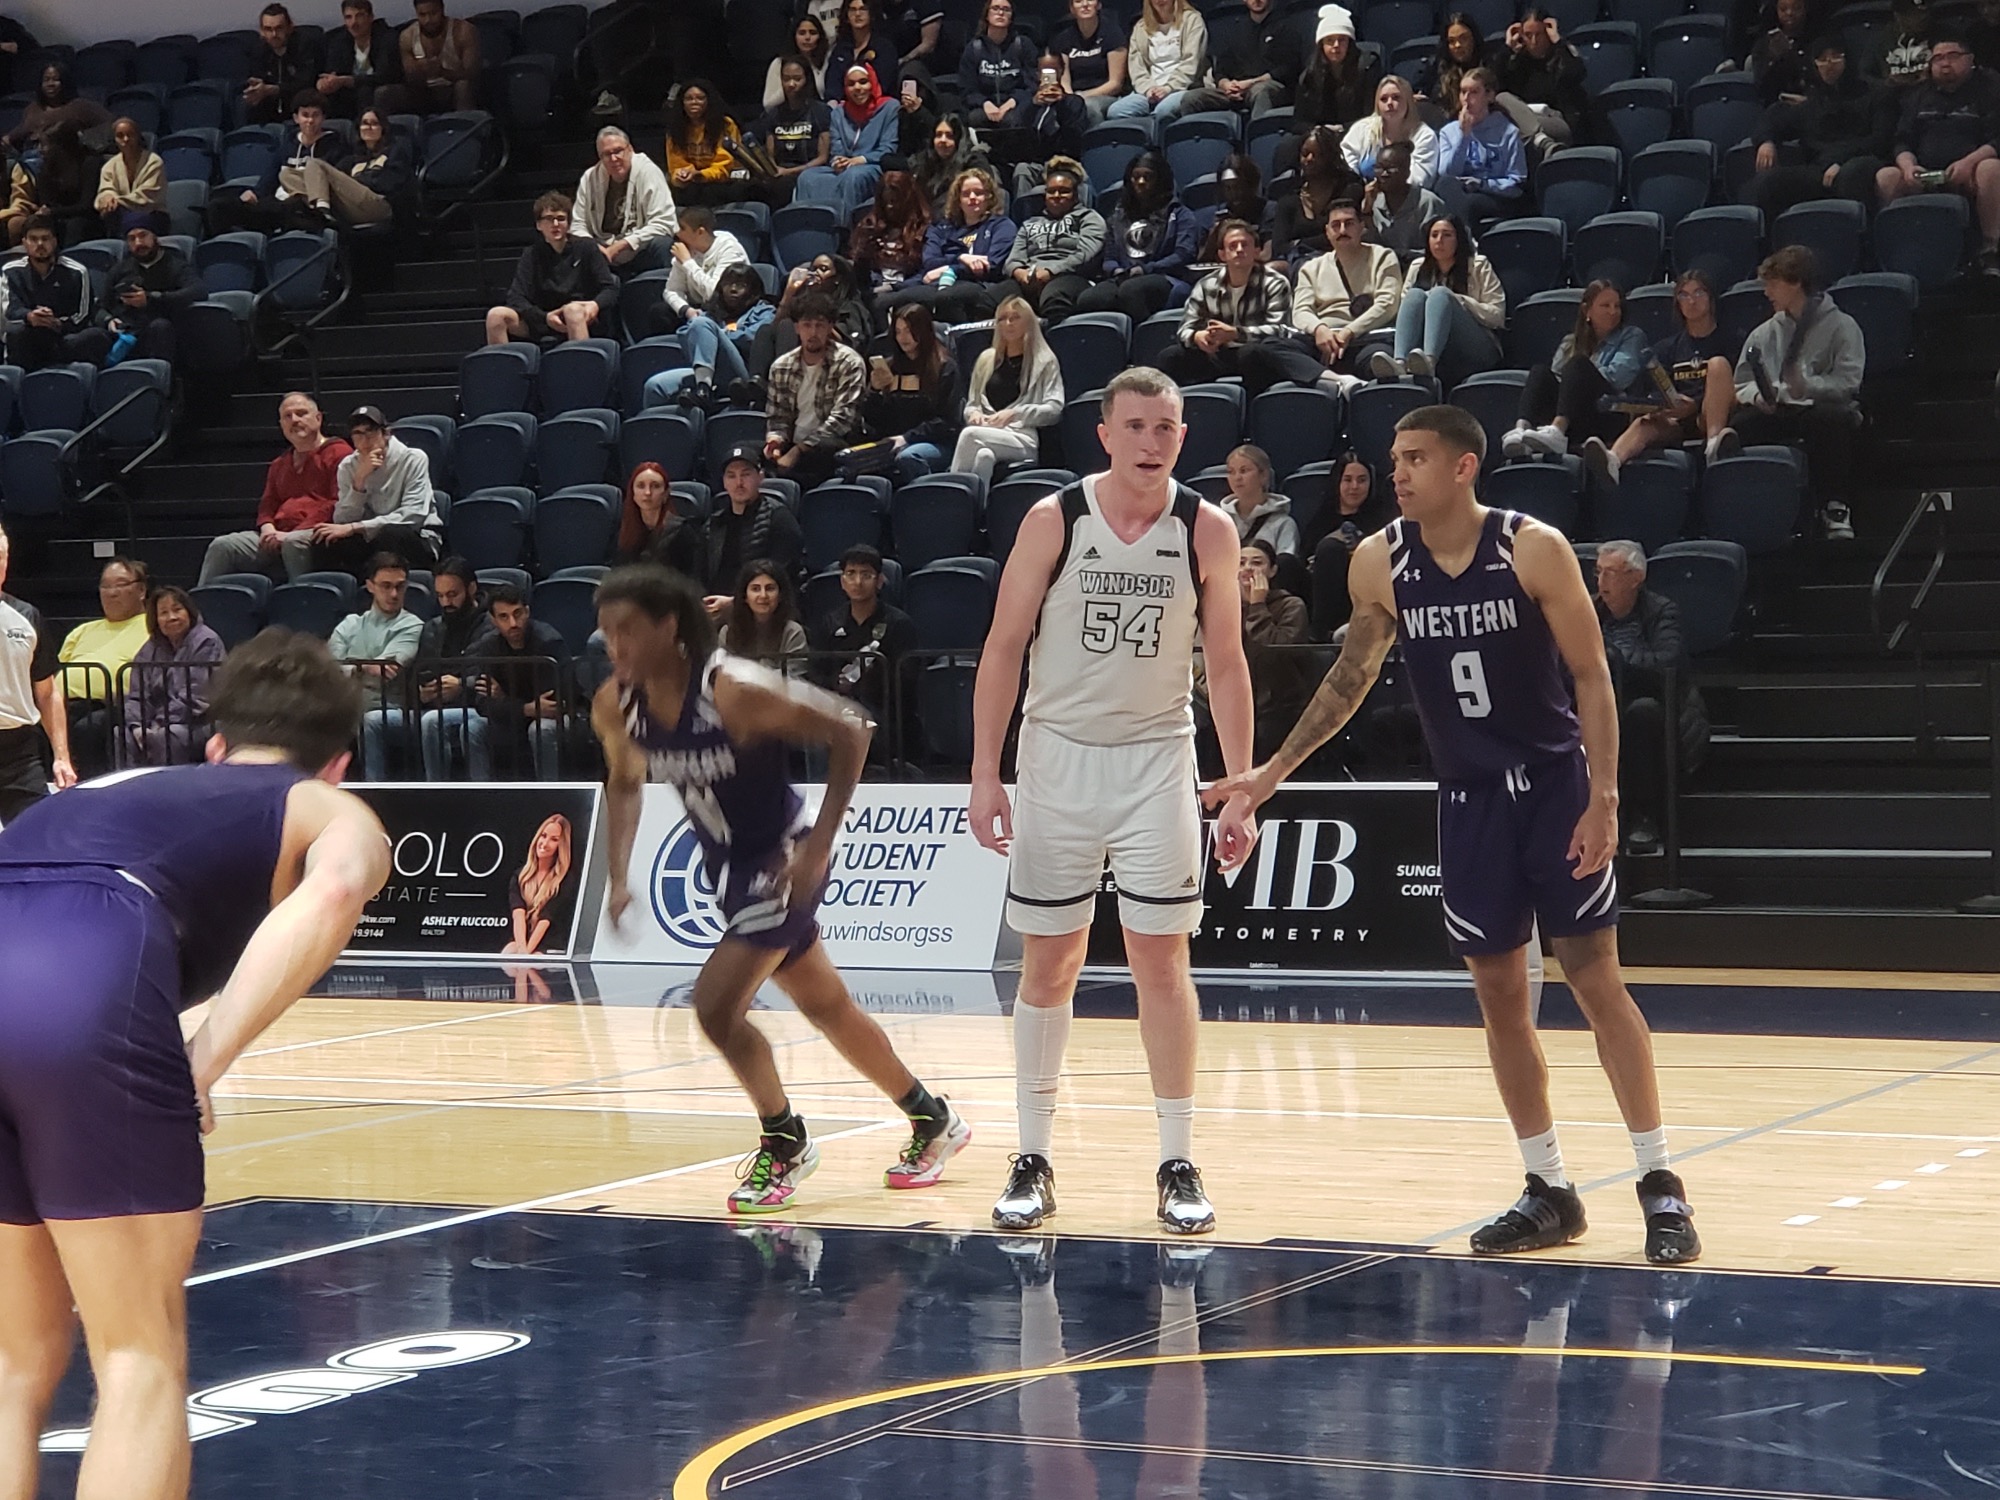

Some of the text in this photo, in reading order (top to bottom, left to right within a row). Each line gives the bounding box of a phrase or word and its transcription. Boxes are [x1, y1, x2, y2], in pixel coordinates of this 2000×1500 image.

[1079, 569, 1175, 598] WINDSOR
[1081, 600, 1164, 658] 54
[1402, 598, 1518, 639] WESTERN
[1450, 650, 1493, 718] 9
[382, 832, 504, 877] OLO
[421, 915, 509, 928] ASHLEY RUCCOLO
